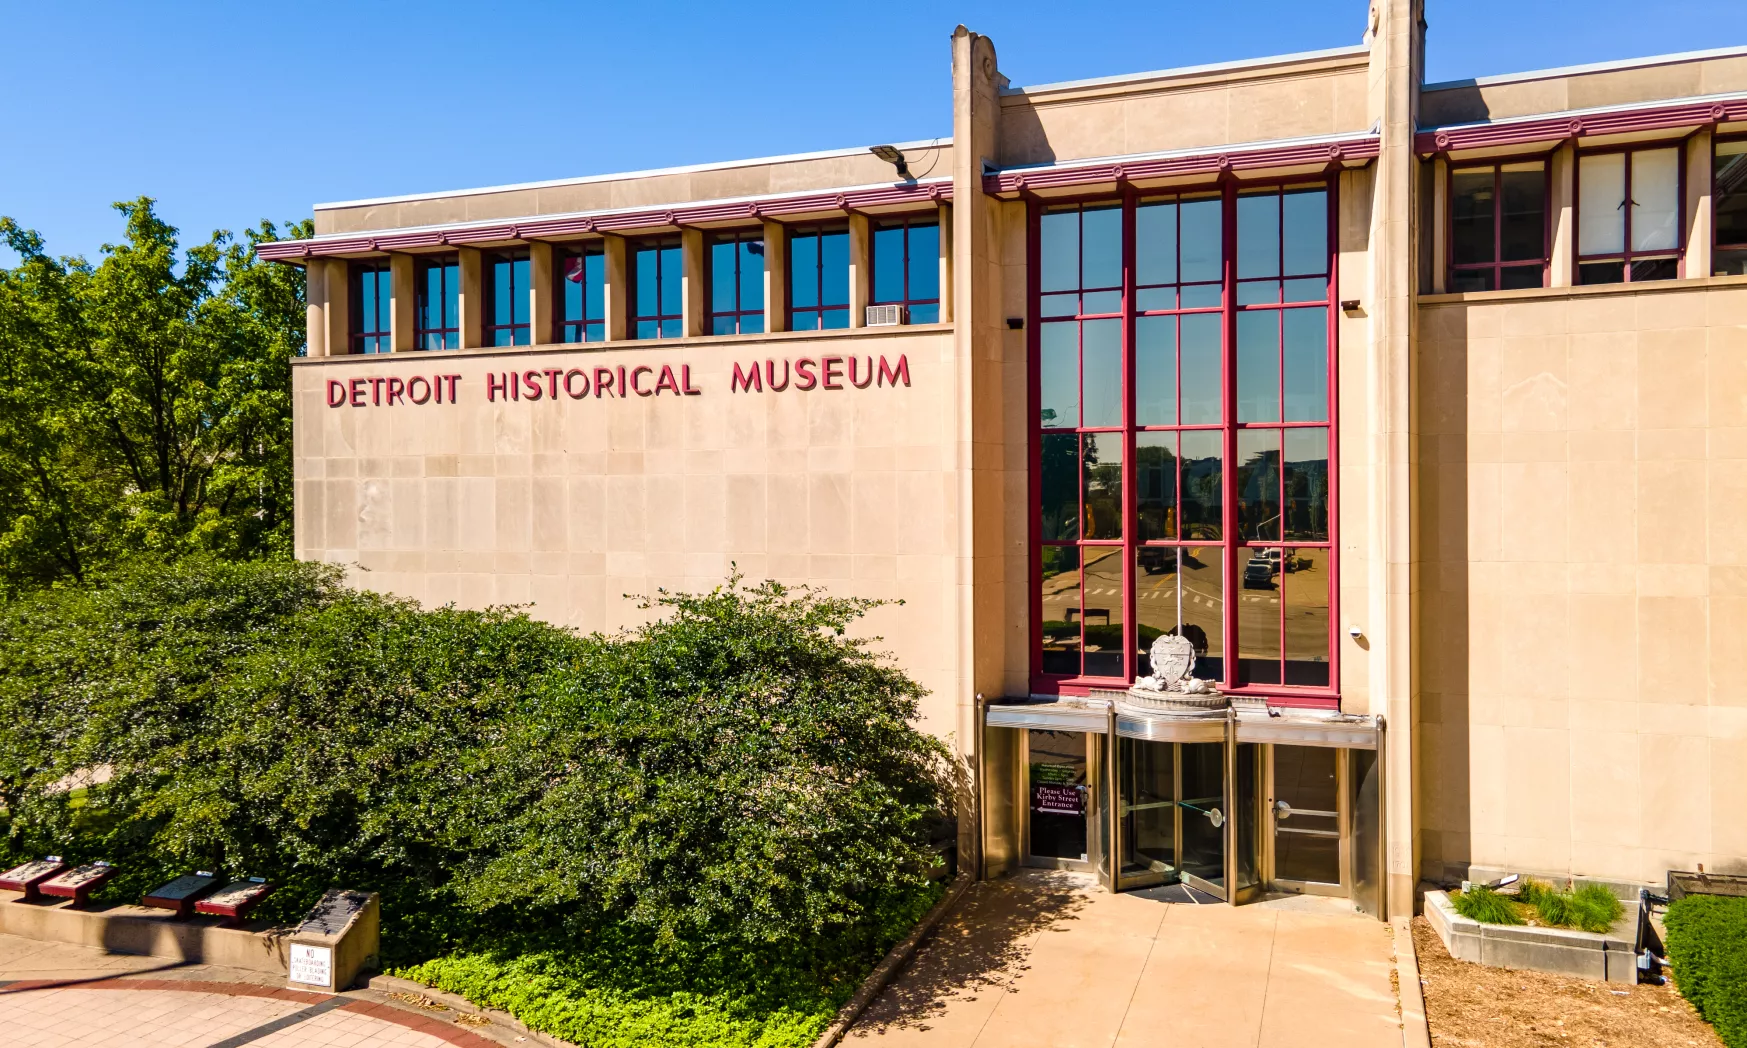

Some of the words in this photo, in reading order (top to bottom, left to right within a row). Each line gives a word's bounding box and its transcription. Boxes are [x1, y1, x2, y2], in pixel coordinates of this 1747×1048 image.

[326, 374, 462, 408] DETROIT
[486, 364, 701, 402] HISTORICAL
[730, 353, 912, 394] MUSEUM
[1062, 788, 1076, 796] Use
[1036, 793, 1056, 801] Kirby
[1058, 794, 1078, 802] Street
[1042, 800, 1074, 808] Entrance
[306, 948, 315, 958] NO
